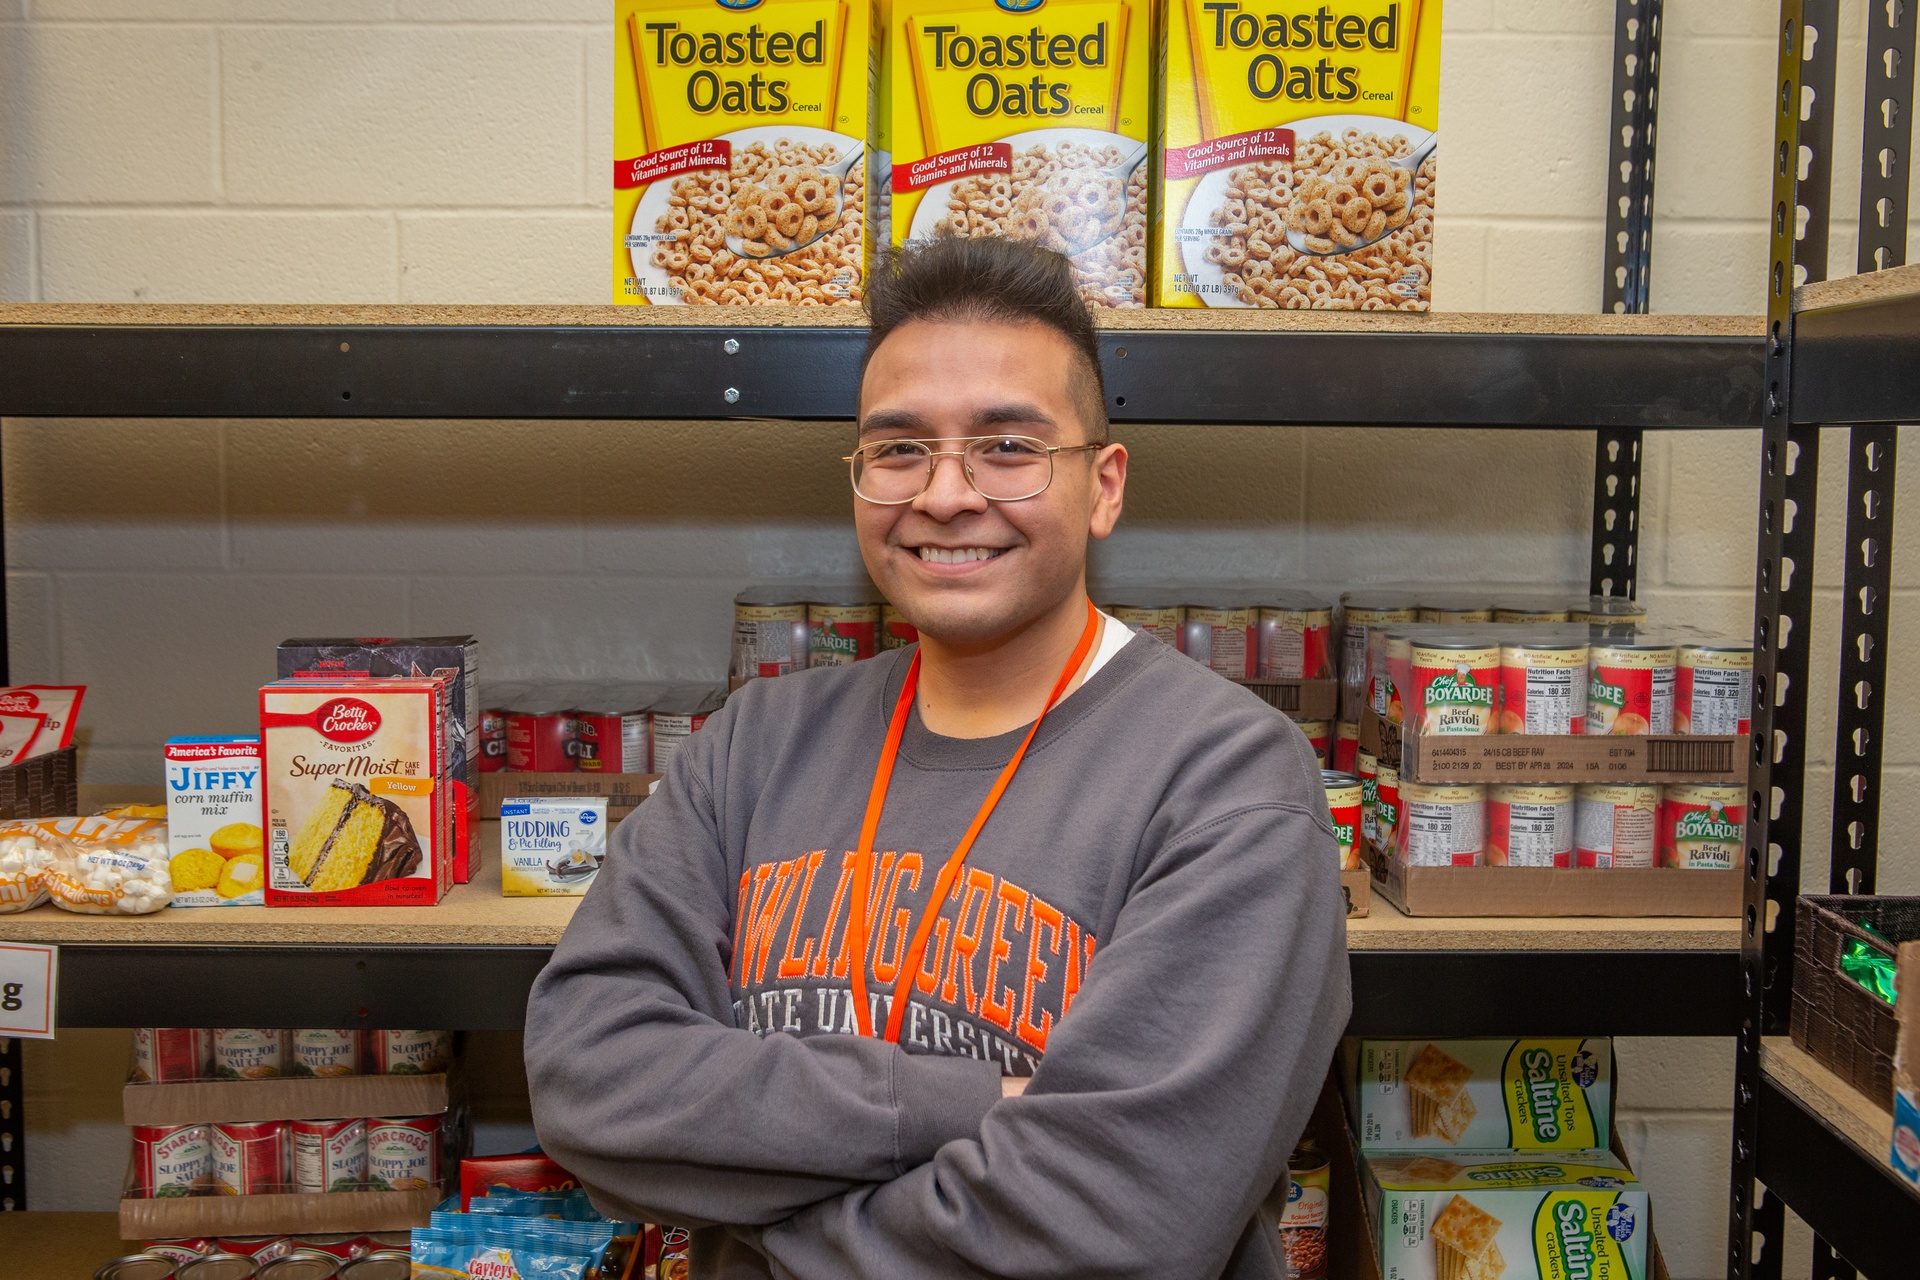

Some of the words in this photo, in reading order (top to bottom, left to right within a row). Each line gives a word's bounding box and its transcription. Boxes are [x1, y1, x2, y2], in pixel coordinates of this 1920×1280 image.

[1203, 2, 1397, 48] Toasted
[646, 20, 822, 64] Toasted
[924, 22, 1105, 67] Toasted
[1248, 54, 1357, 100] Oats
[687, 70, 787, 112] Oats
[966, 73, 1070, 115] Oats
[1362, 91, 1393, 101] Cereal
[792, 103, 821, 112] Cereal
[1074, 105, 1104, 114] Cereal
[1187, 142, 1213, 159] Good
[1215, 140, 1248, 152] Source
[1251, 132, 1261, 144] of
[1264, 132, 1275, 142] 12
[633, 153, 657, 170] Good
[659, 147, 688, 162] Source
[690, 143, 700, 155] of
[702, 142, 713, 153] 12
[911, 157, 936, 174] Good
[938, 151, 968, 166] Source
[970, 147, 980, 158] of
[983, 146, 993, 156] 12
[1184, 154, 1225, 172] Vitamins
[1227, 146, 1246, 160] and
[1248, 143, 1290, 157] Minerals
[631, 165, 668, 182] Vitamins
[670, 158, 686, 171] and
[688, 154, 727, 167] Minerals
[909, 168, 947, 186] Vitamins
[949, 161, 966, 175] and
[969, 157, 1008, 170] Minerals
[1174, 274, 1186, 282] NET
[1188, 274, 1198, 282] WT
[658, 287, 668, 296] LB)
[669, 288, 683, 296] 397g
[1193, 284, 1209, 293] (0.87
[1211, 285, 1222, 294] LB)
[1223, 285, 1239, 295] 397g
[1432, 675, 1454, 687] Chef
[1425, 687, 1493, 705] BOYARDEE
[333, 704, 367, 722] Betty
[1440, 714, 1479, 726] Ravioli
[1451, 708, 1470, 716] Beef
[323, 716, 373, 733] Crocker
[168, 746, 216, 756] America's
[218, 746, 257, 756] Favorite
[1483, 749, 1500, 757] 24/15
[1502, 749, 1512, 757] CB
[1513, 748, 1530, 757] BEEF
[1531, 748, 1545, 756] RAV
[1609, 749, 1623, 757] EST
[1433, 762, 1450, 770] 2100
[1452, 762, 1469, 770] 2129
[1495, 762, 1516, 770] BEST
[1518, 762, 1528, 770] BY
[386, 781, 417, 792] Yellow
[175, 795, 205, 804] corn
[208, 791, 253, 803] muffin
[200, 804, 228, 815] mix
[1511, 804, 1538, 812] Nutrition
[1684, 811, 1707, 824] Chef
[508, 820, 570, 838] PUDDING
[1440, 823, 1452, 831] 320
[1675, 821, 1744, 841] BOYARDEE
[508, 838, 518, 851] &
[534, 838, 562, 853] Filling
[1702, 844, 1721, 852] Beef
[87, 856, 100, 864] NET
[101, 857, 111, 865] WT
[514, 858, 542, 866] VANILLA
[1689, 849, 1730, 862] Ravioli
[1, 982, 23, 1011] g
[1557, 1055, 1574, 1104] Unsalted
[1514, 1079, 1528, 1125] crackers
[1525, 1051, 1558, 1138] Saltine
[1565, 1106, 1575, 1131] Tops
[392, 1131, 428, 1152] CROSS
[1590, 1207, 1609, 1258] Unsalted
[1546, 1232, 1560, 1280] crackers
[469, 1259, 514, 1280] Cayleys
